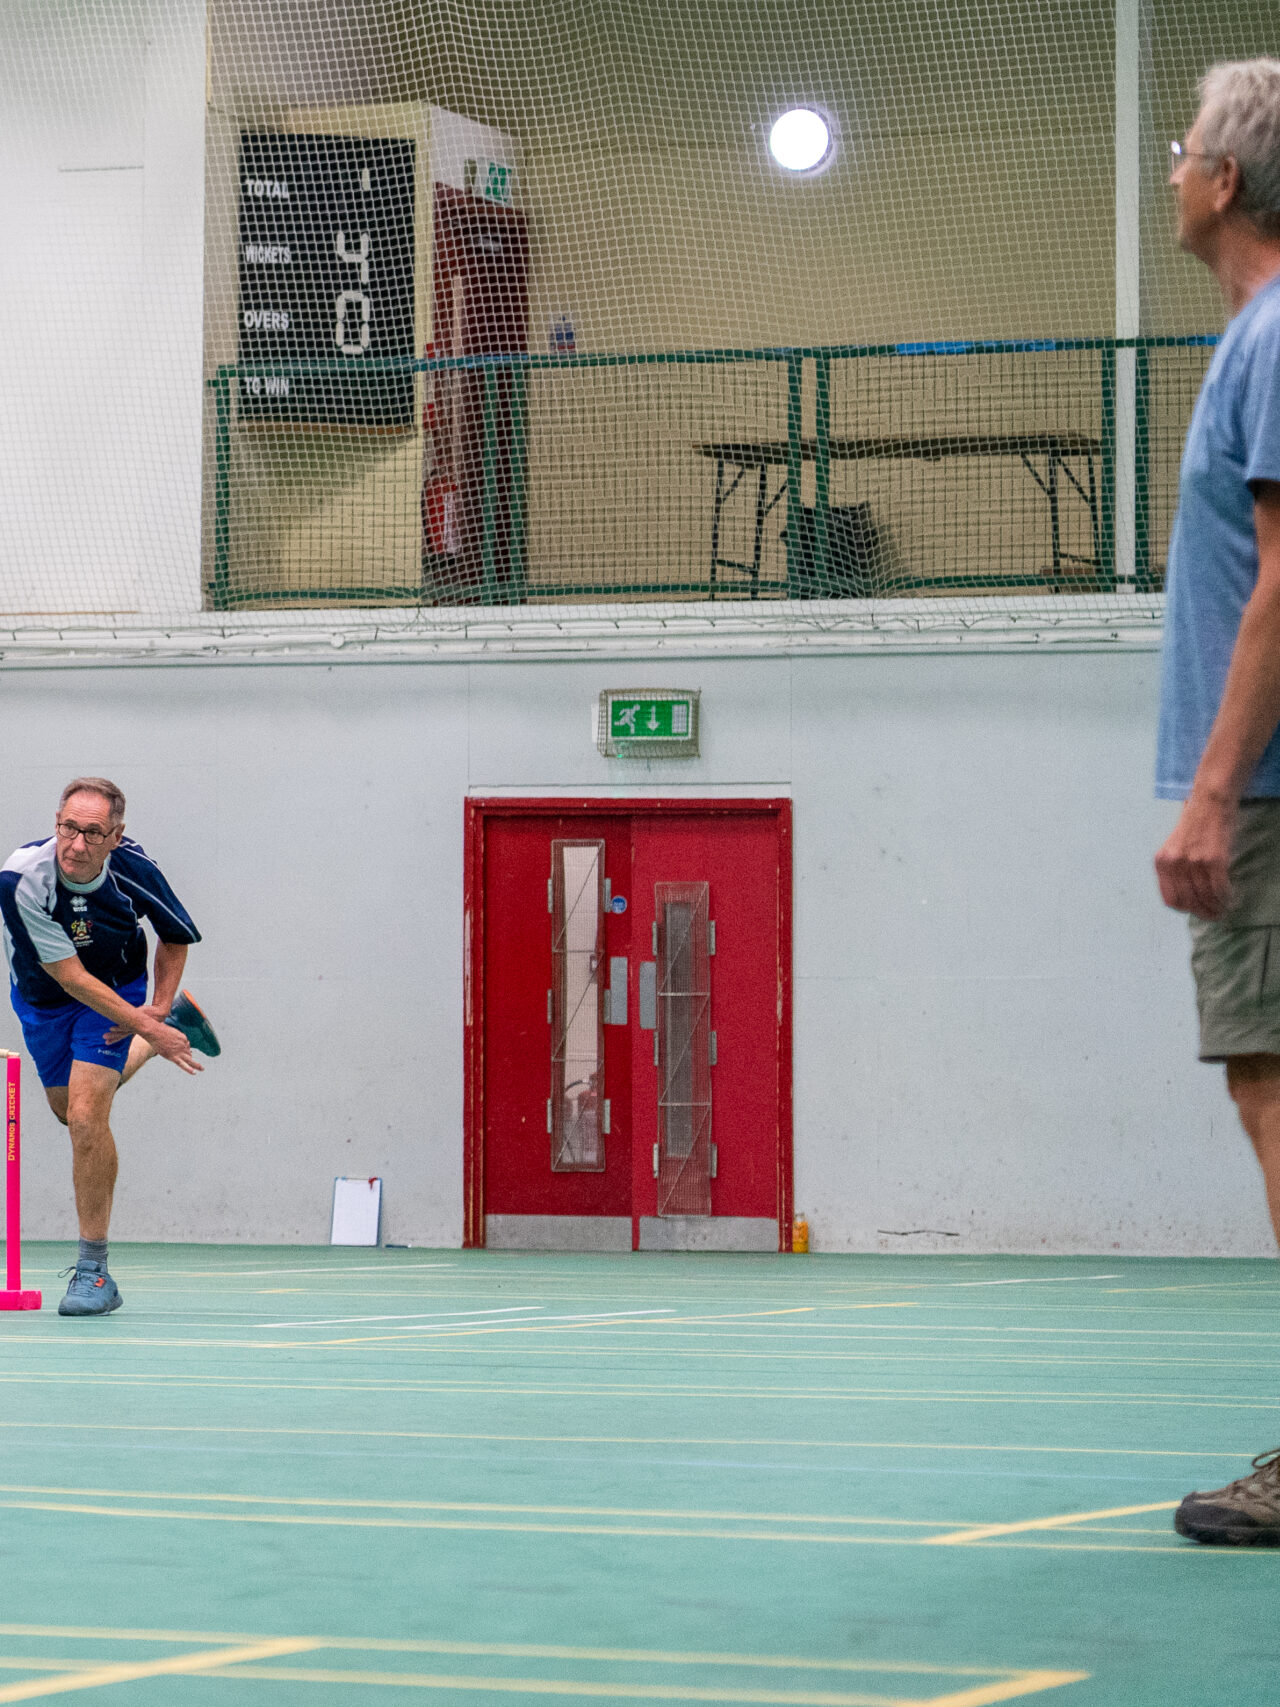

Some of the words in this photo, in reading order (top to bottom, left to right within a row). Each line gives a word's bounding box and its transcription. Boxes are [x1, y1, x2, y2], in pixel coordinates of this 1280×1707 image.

[245, 179, 289, 199] TOTAL
[245, 245, 291, 264] WICKETS
[337, 231, 370, 285] 4
[244, 311, 290, 331] OVERS
[335, 290, 370, 355] 0
[244, 376, 262, 394] TO
[264, 376, 290, 396] WIN
[8, 1082, 16, 1120] CRICKET
